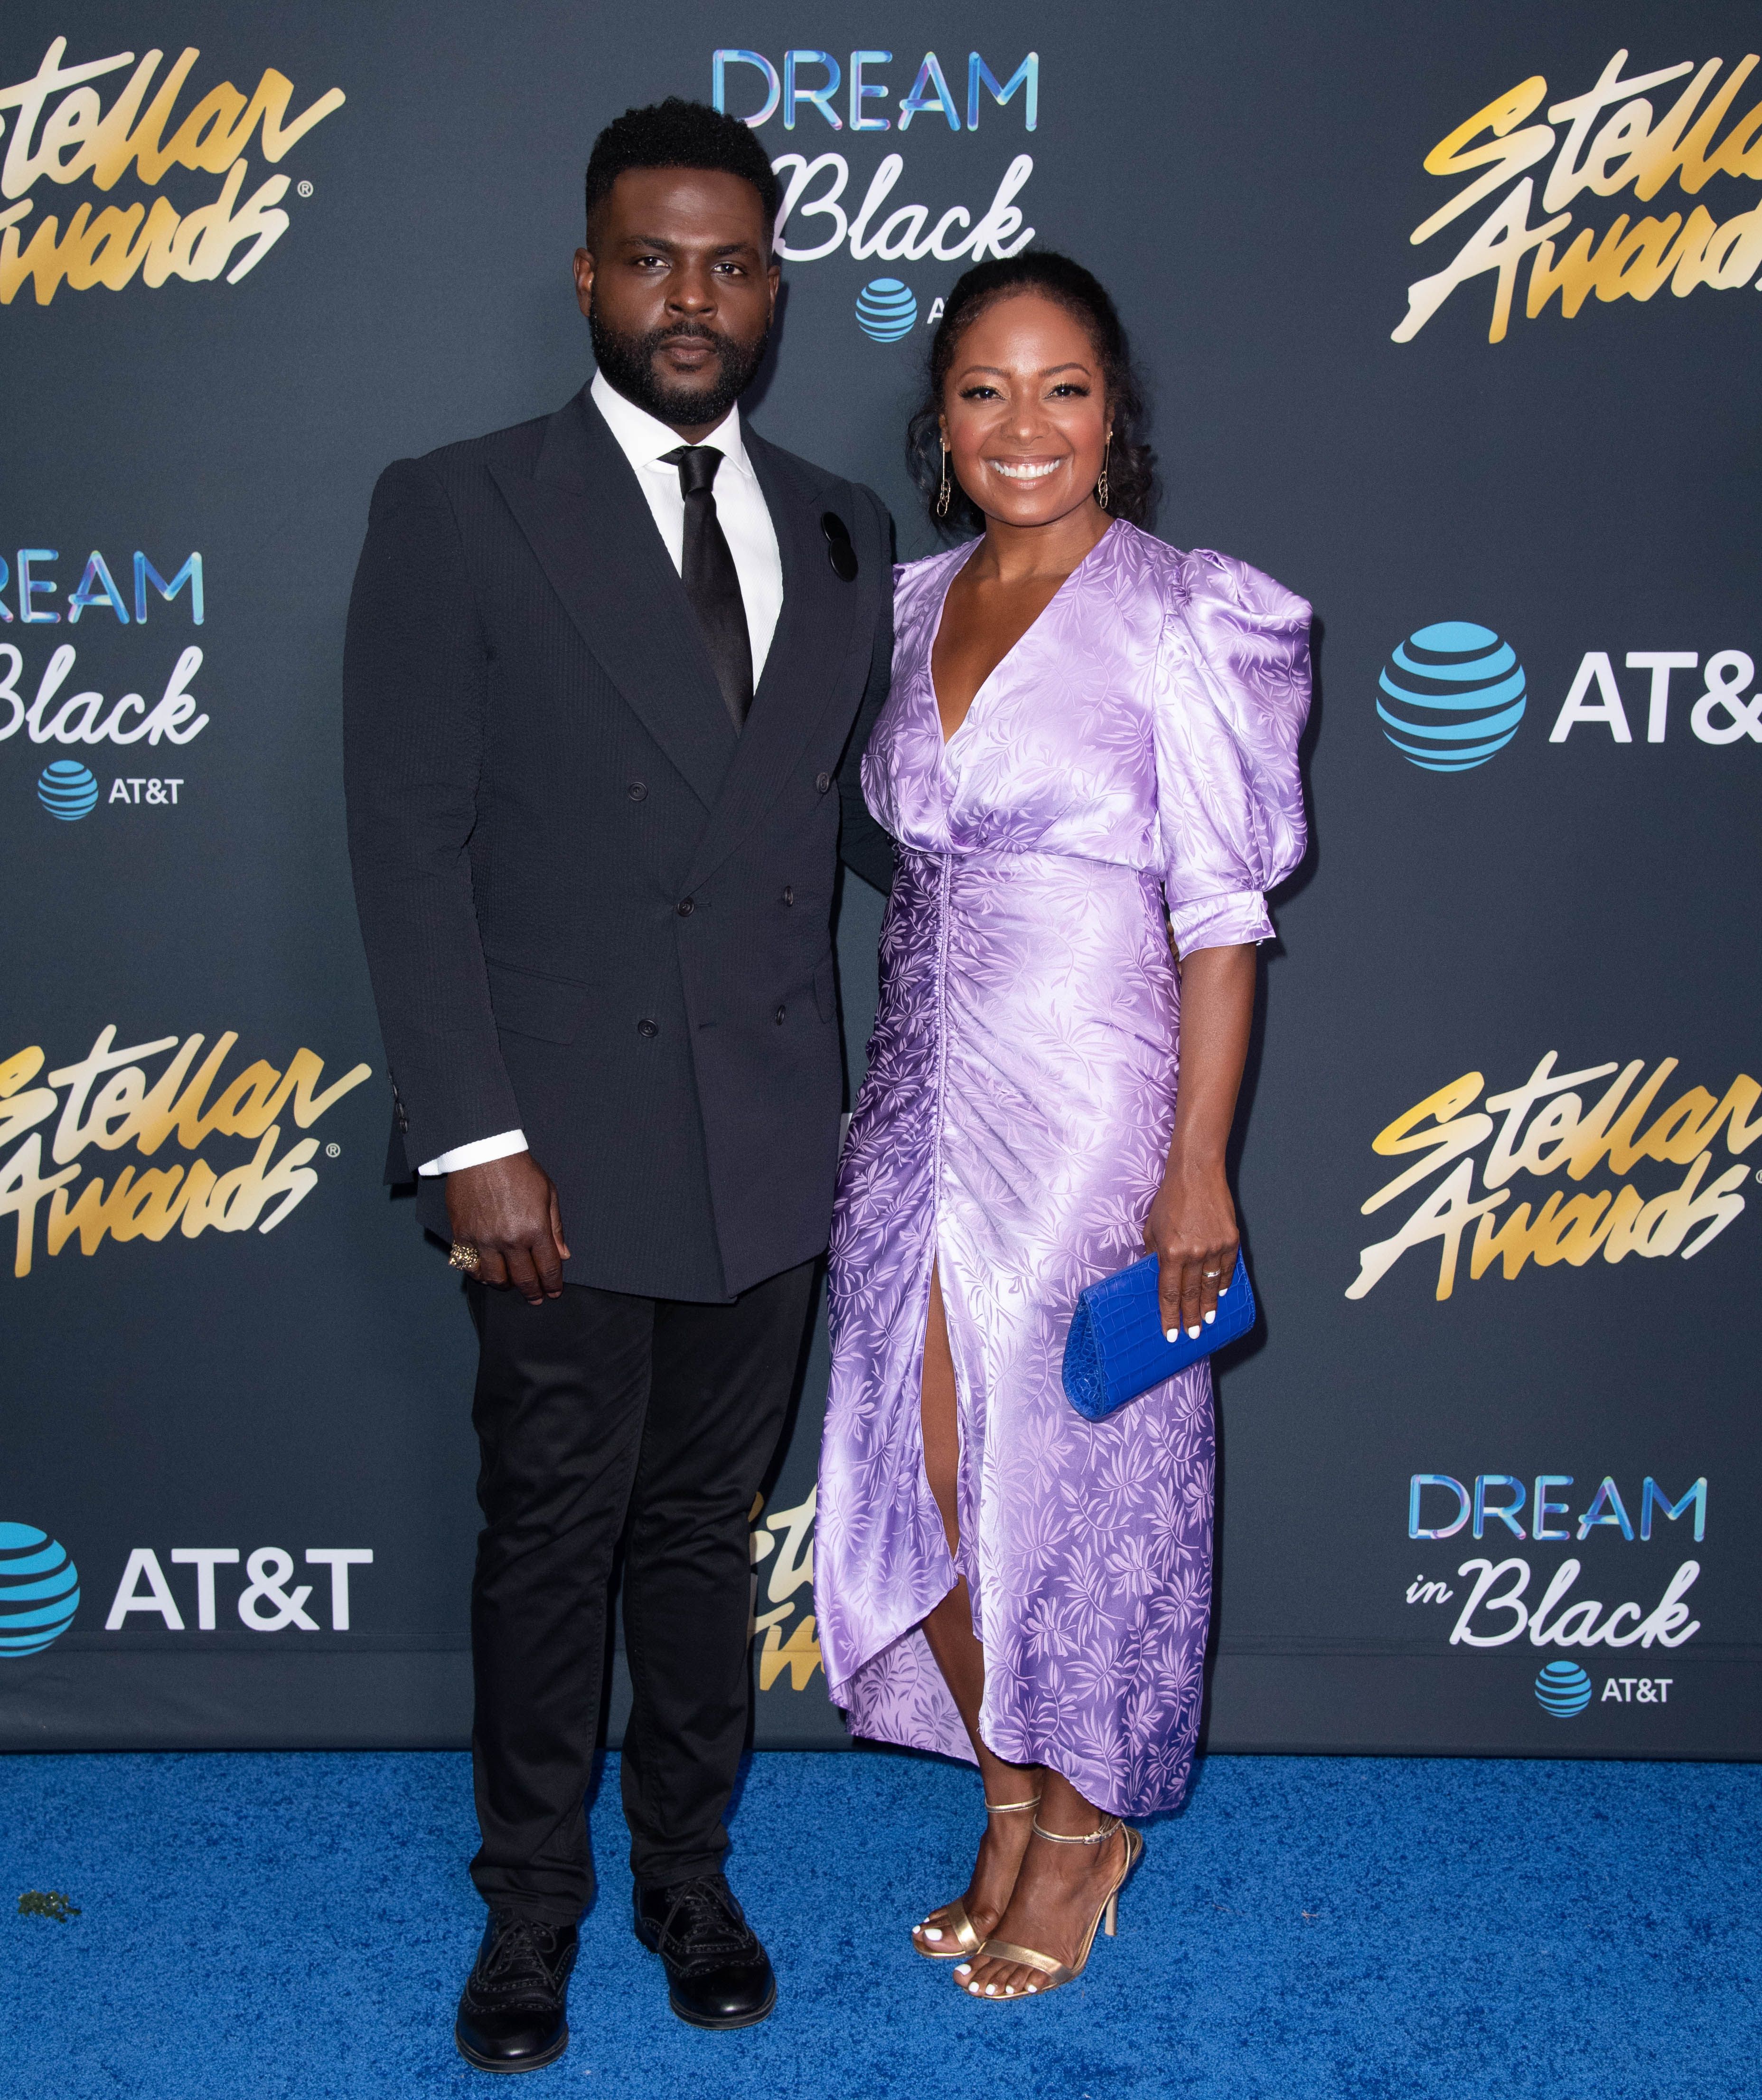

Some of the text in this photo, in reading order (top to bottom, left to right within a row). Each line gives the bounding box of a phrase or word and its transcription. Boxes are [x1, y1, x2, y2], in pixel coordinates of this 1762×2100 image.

[0, 36, 346, 200] tellar
[713, 49, 1039, 132] DREAM
[0, 158, 291, 306] wards
[772, 153, 1036, 262] Black
[1391, 176, 1762, 344] Award
[0, 549, 205, 626] EAM
[108, 778, 184, 805] AT&T
[1360, 1050, 1762, 1215] Stellar
[1344, 1150, 1751, 1301] Awards
[1408, 1474, 1707, 1543] DREAM
[104, 1546, 374, 1632] AT&T
[1406, 1557, 1701, 1648] in Black
[1601, 1678, 1673, 1703] AT&T
